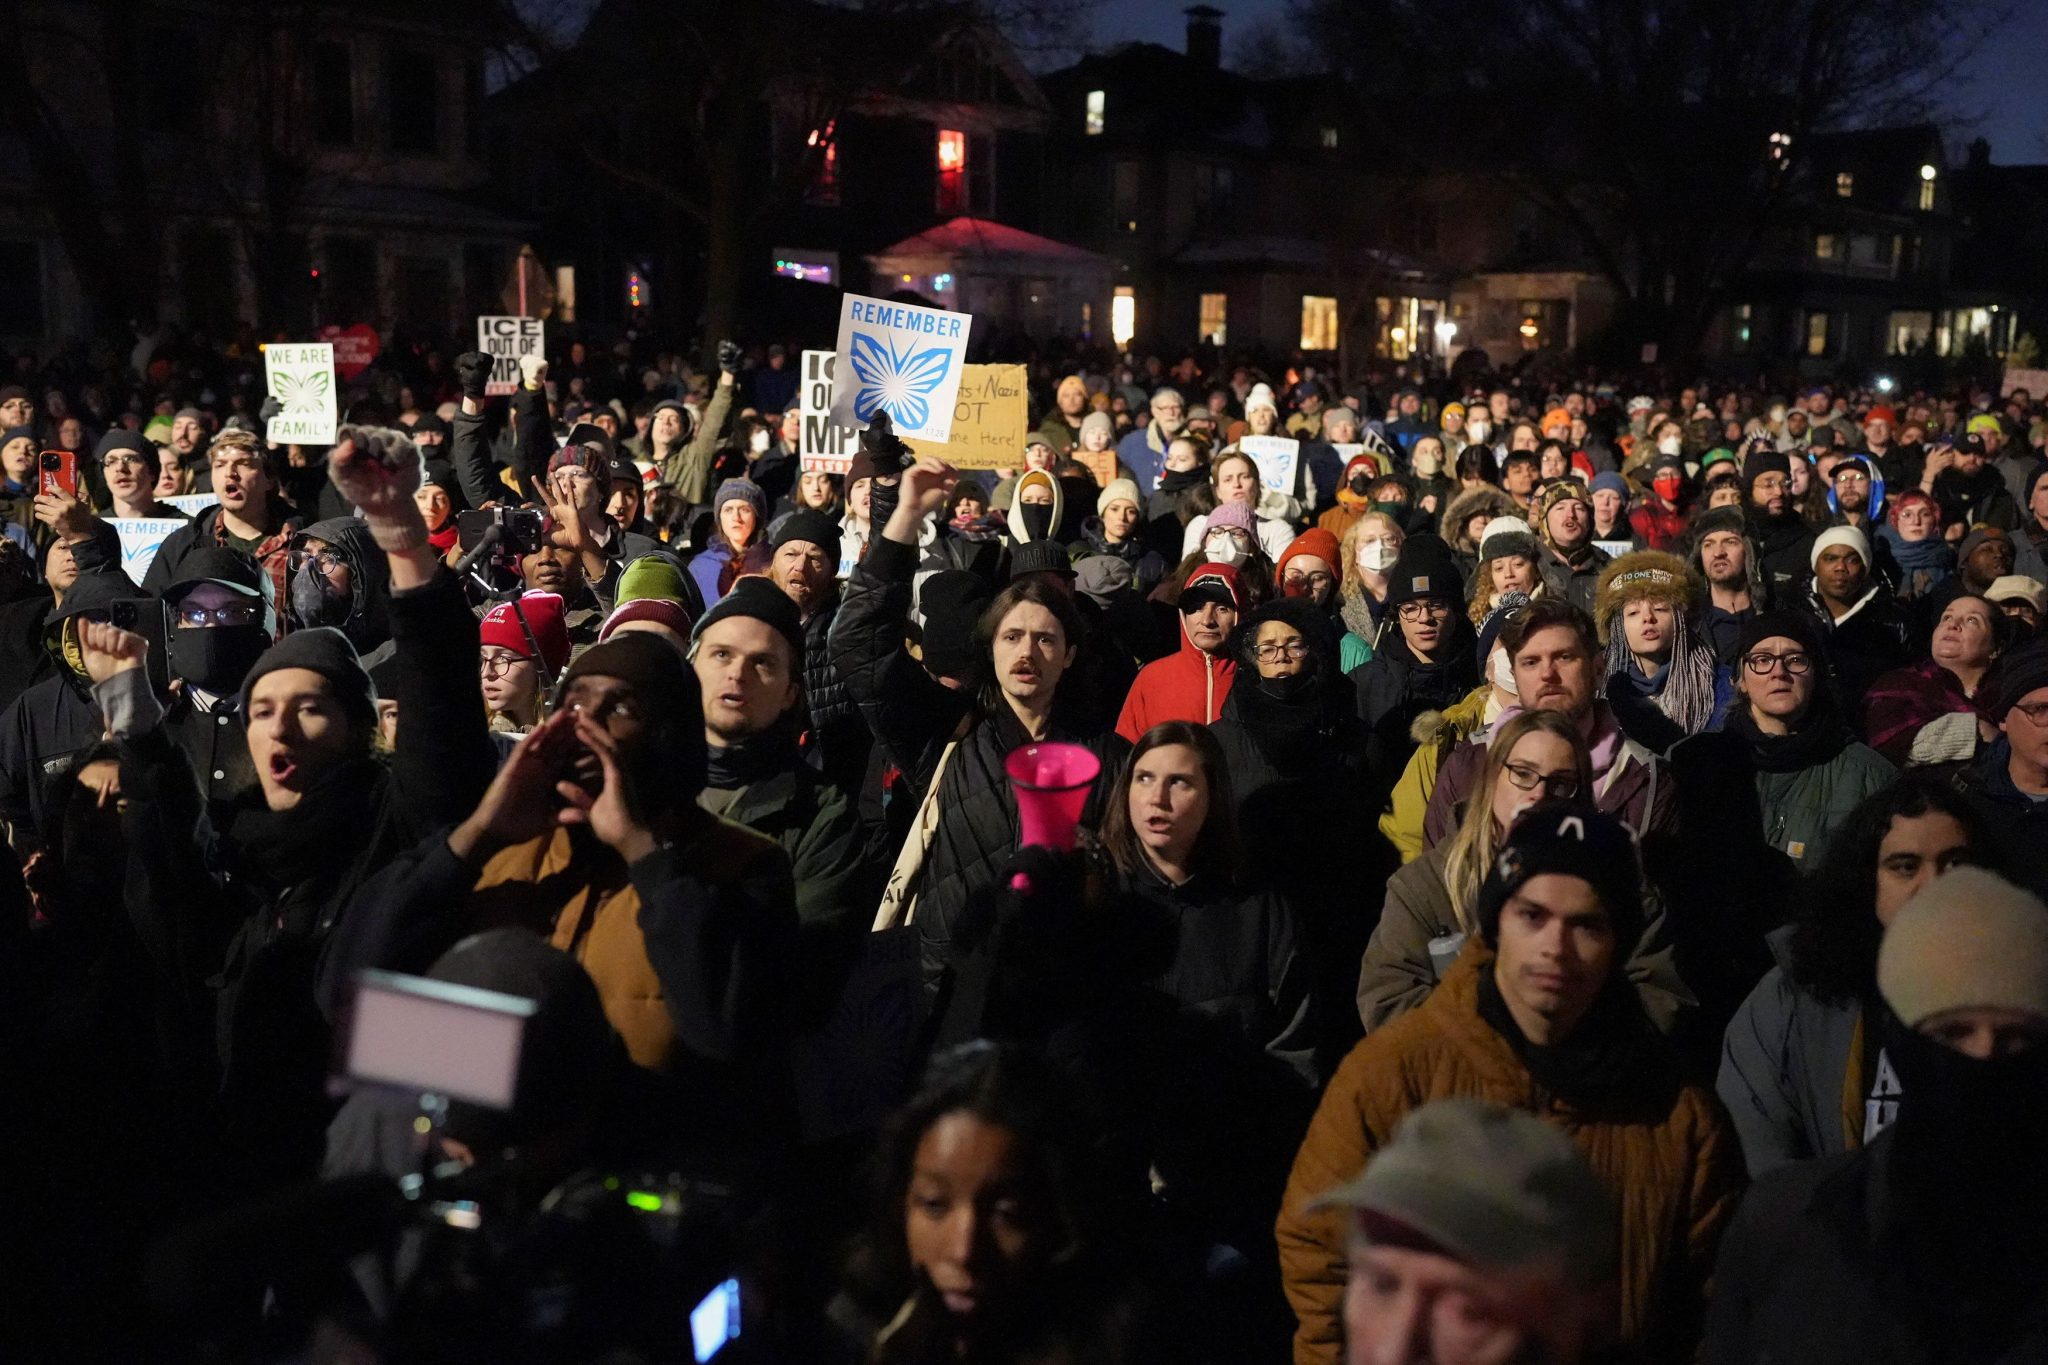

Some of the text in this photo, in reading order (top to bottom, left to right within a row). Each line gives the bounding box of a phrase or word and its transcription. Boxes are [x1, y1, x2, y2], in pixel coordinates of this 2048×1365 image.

[484, 319, 540, 336] ICE
[851, 301, 961, 338] REMEMBER
[488, 337, 536, 355] OUT OF
[270, 349, 329, 364] WE ARE
[492, 358, 517, 381] MP
[984, 375, 1020, 400] Nazis
[954, 402, 989, 424] OT
[273, 421, 330, 435] FAMILY
[806, 415, 858, 455] MP
[950, 433, 969, 445] me
[1633, 570, 1652, 580] ONE
